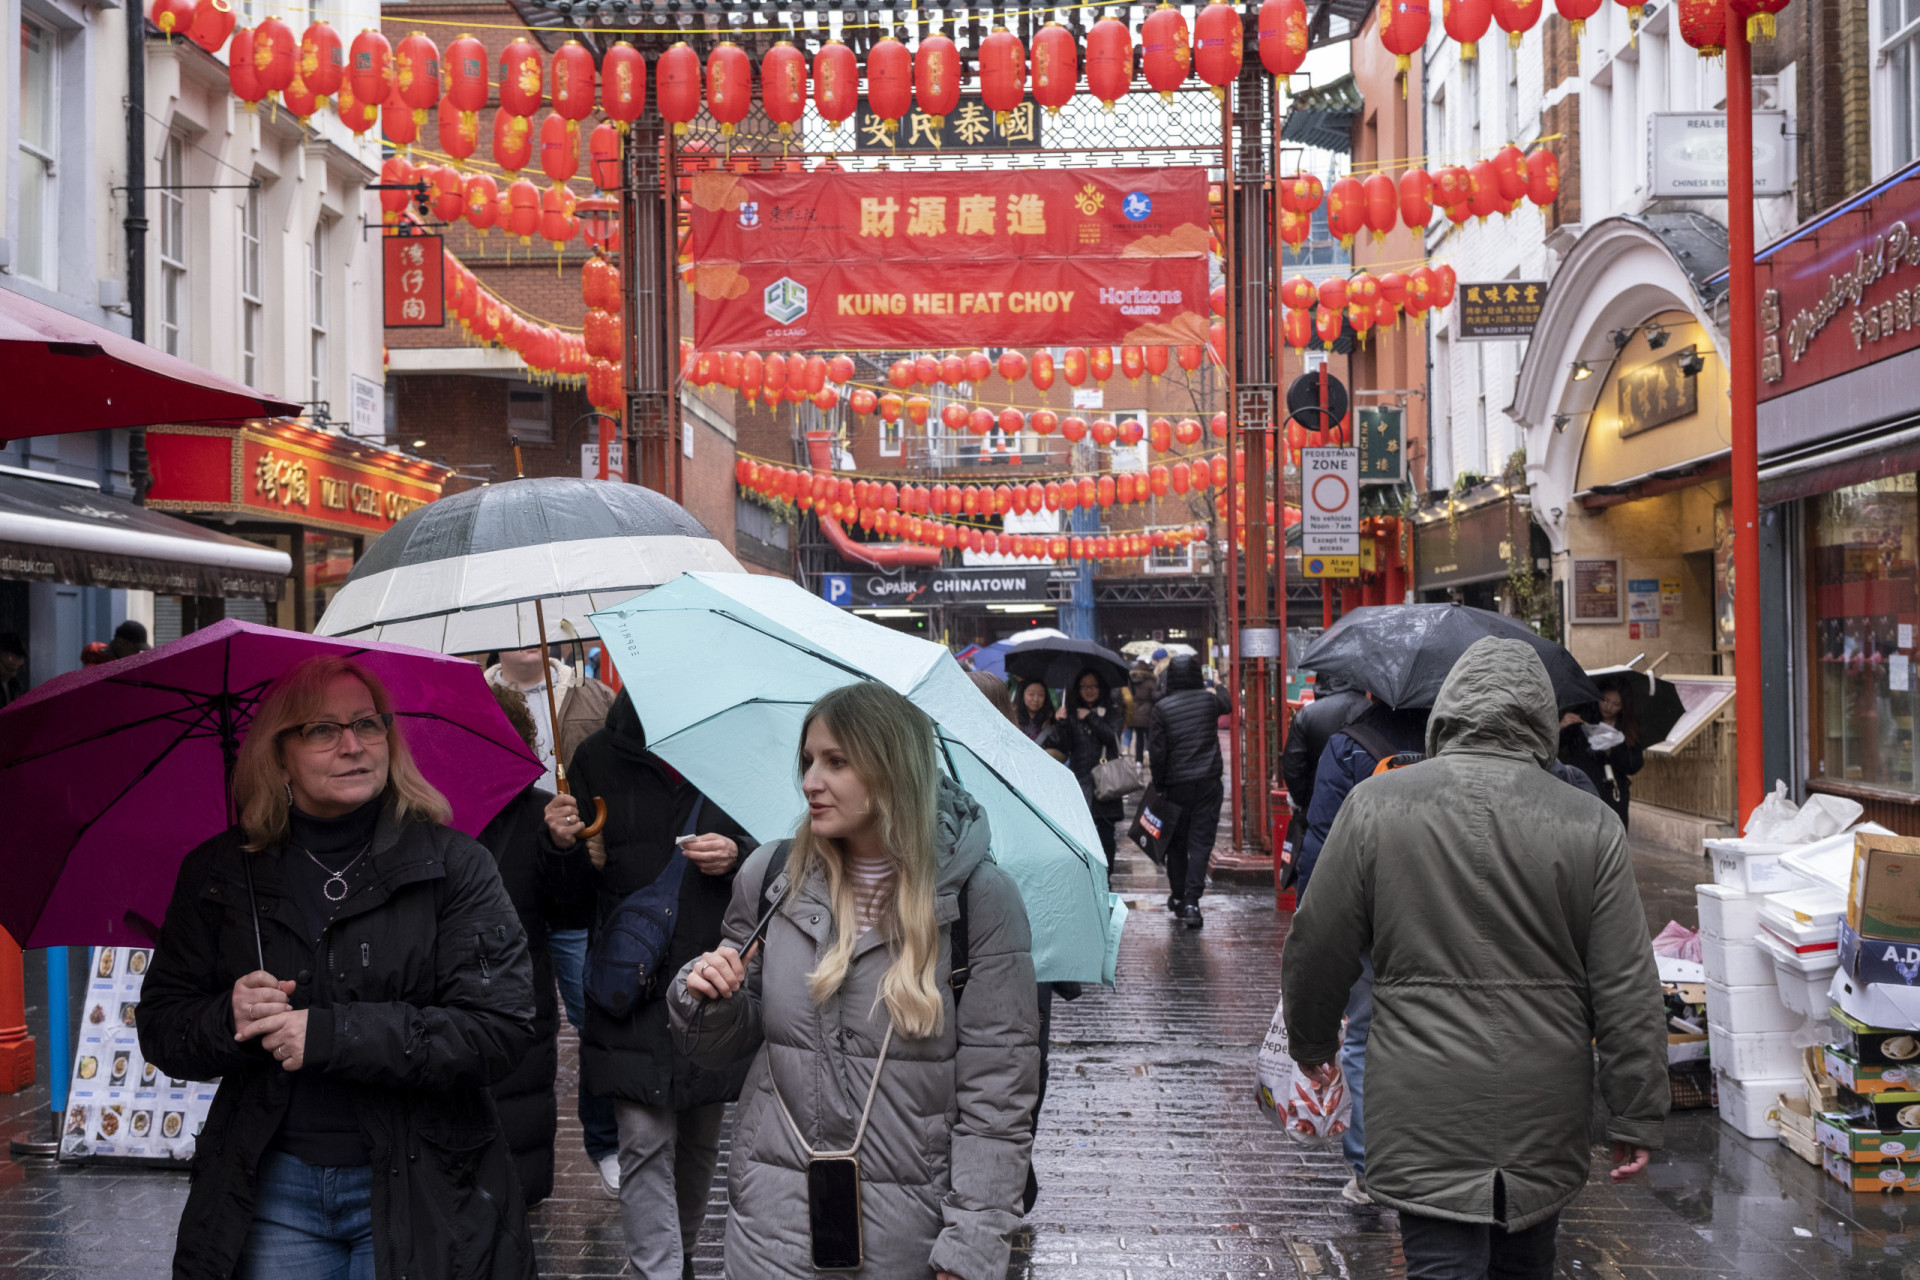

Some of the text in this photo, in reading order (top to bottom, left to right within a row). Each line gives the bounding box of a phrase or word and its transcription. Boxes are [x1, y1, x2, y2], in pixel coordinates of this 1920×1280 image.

[1687, 120, 1711, 128] REAL
[859, 194, 1047, 238] 財源廣進
[1099, 286, 1182, 305] Horizons
[1466, 284, 1539, 304] 風味食堂
[838, 291, 1075, 316] KUNG HEI FAT CHOY
[1120, 304, 1161, 315] CASINO
[783, 328, 806, 336] LAND
[592, 456, 623, 466] ZN
[1305, 450, 1356, 458] PEDESTRIAN
[1312, 460, 1348, 470] ZONE
[351, 482, 383, 517] CHAI
[831, 579, 846, 601] P
[933, 578, 1027, 592] CHINATOWN
